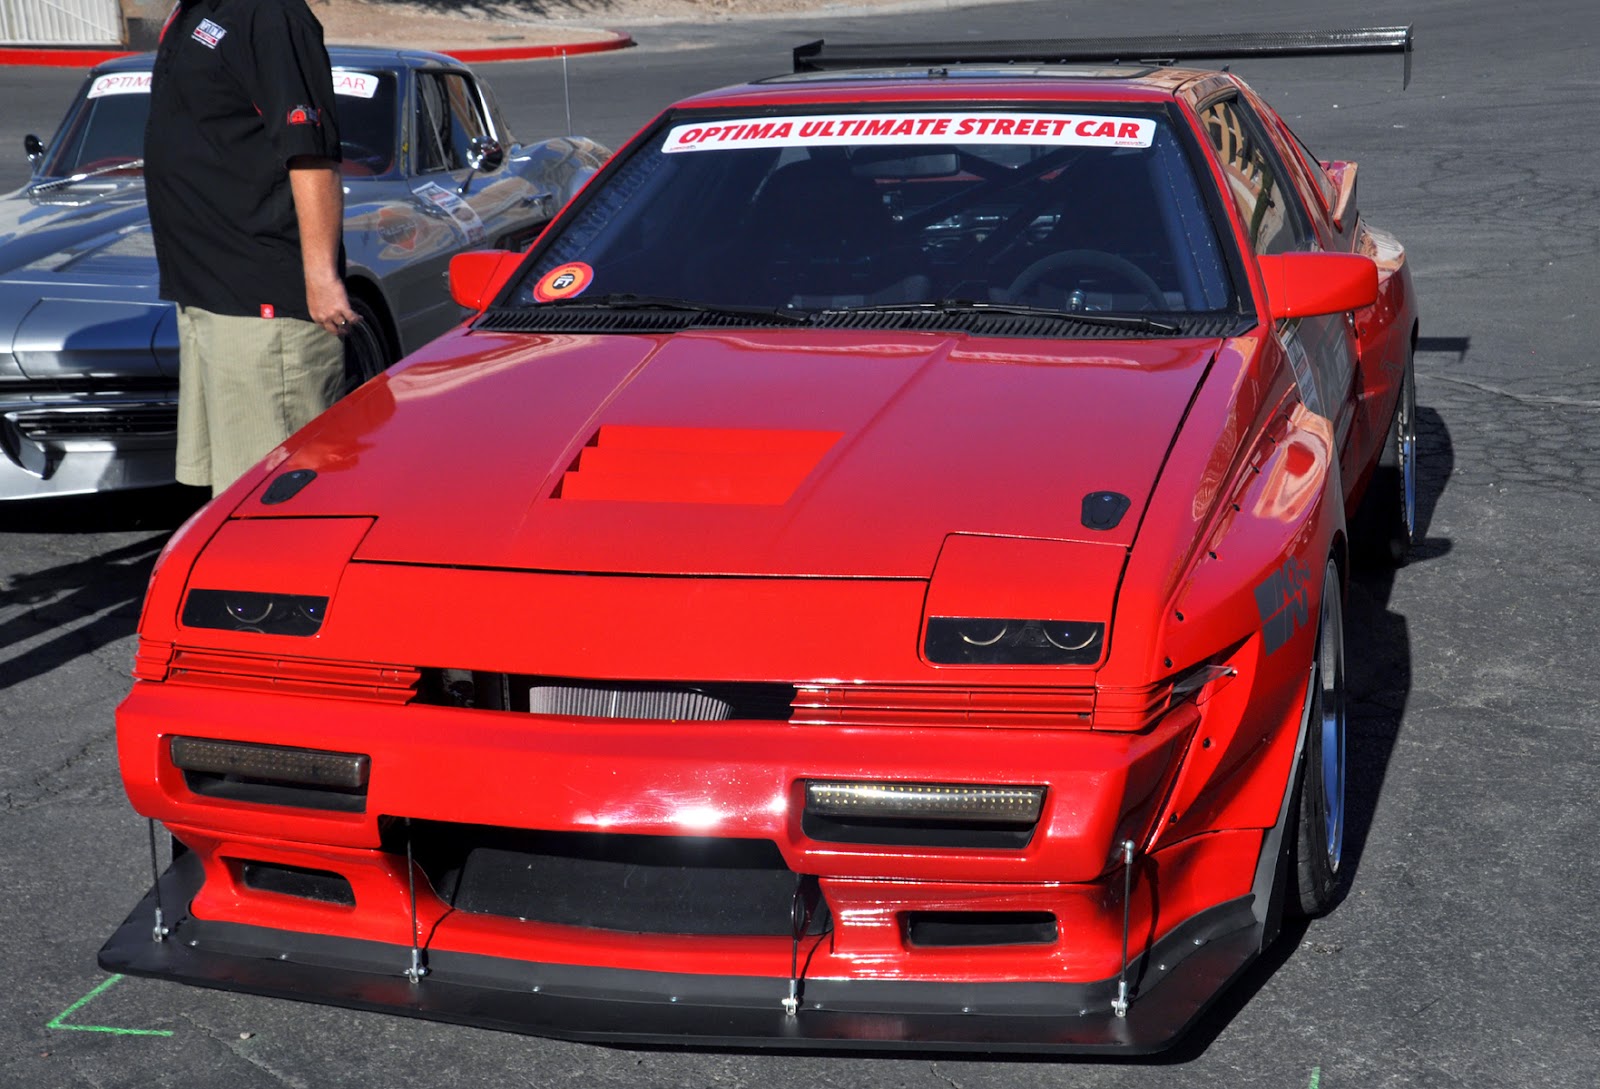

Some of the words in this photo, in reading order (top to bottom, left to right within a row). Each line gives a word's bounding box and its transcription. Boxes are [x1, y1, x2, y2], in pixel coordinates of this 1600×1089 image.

[96, 76, 152, 91] OPTIM
[678, 123, 794, 144] OPTIMA
[798, 118, 952, 138] ULTIMATE
[955, 118, 1072, 136] STREET
[1075, 120, 1140, 138] CAR
